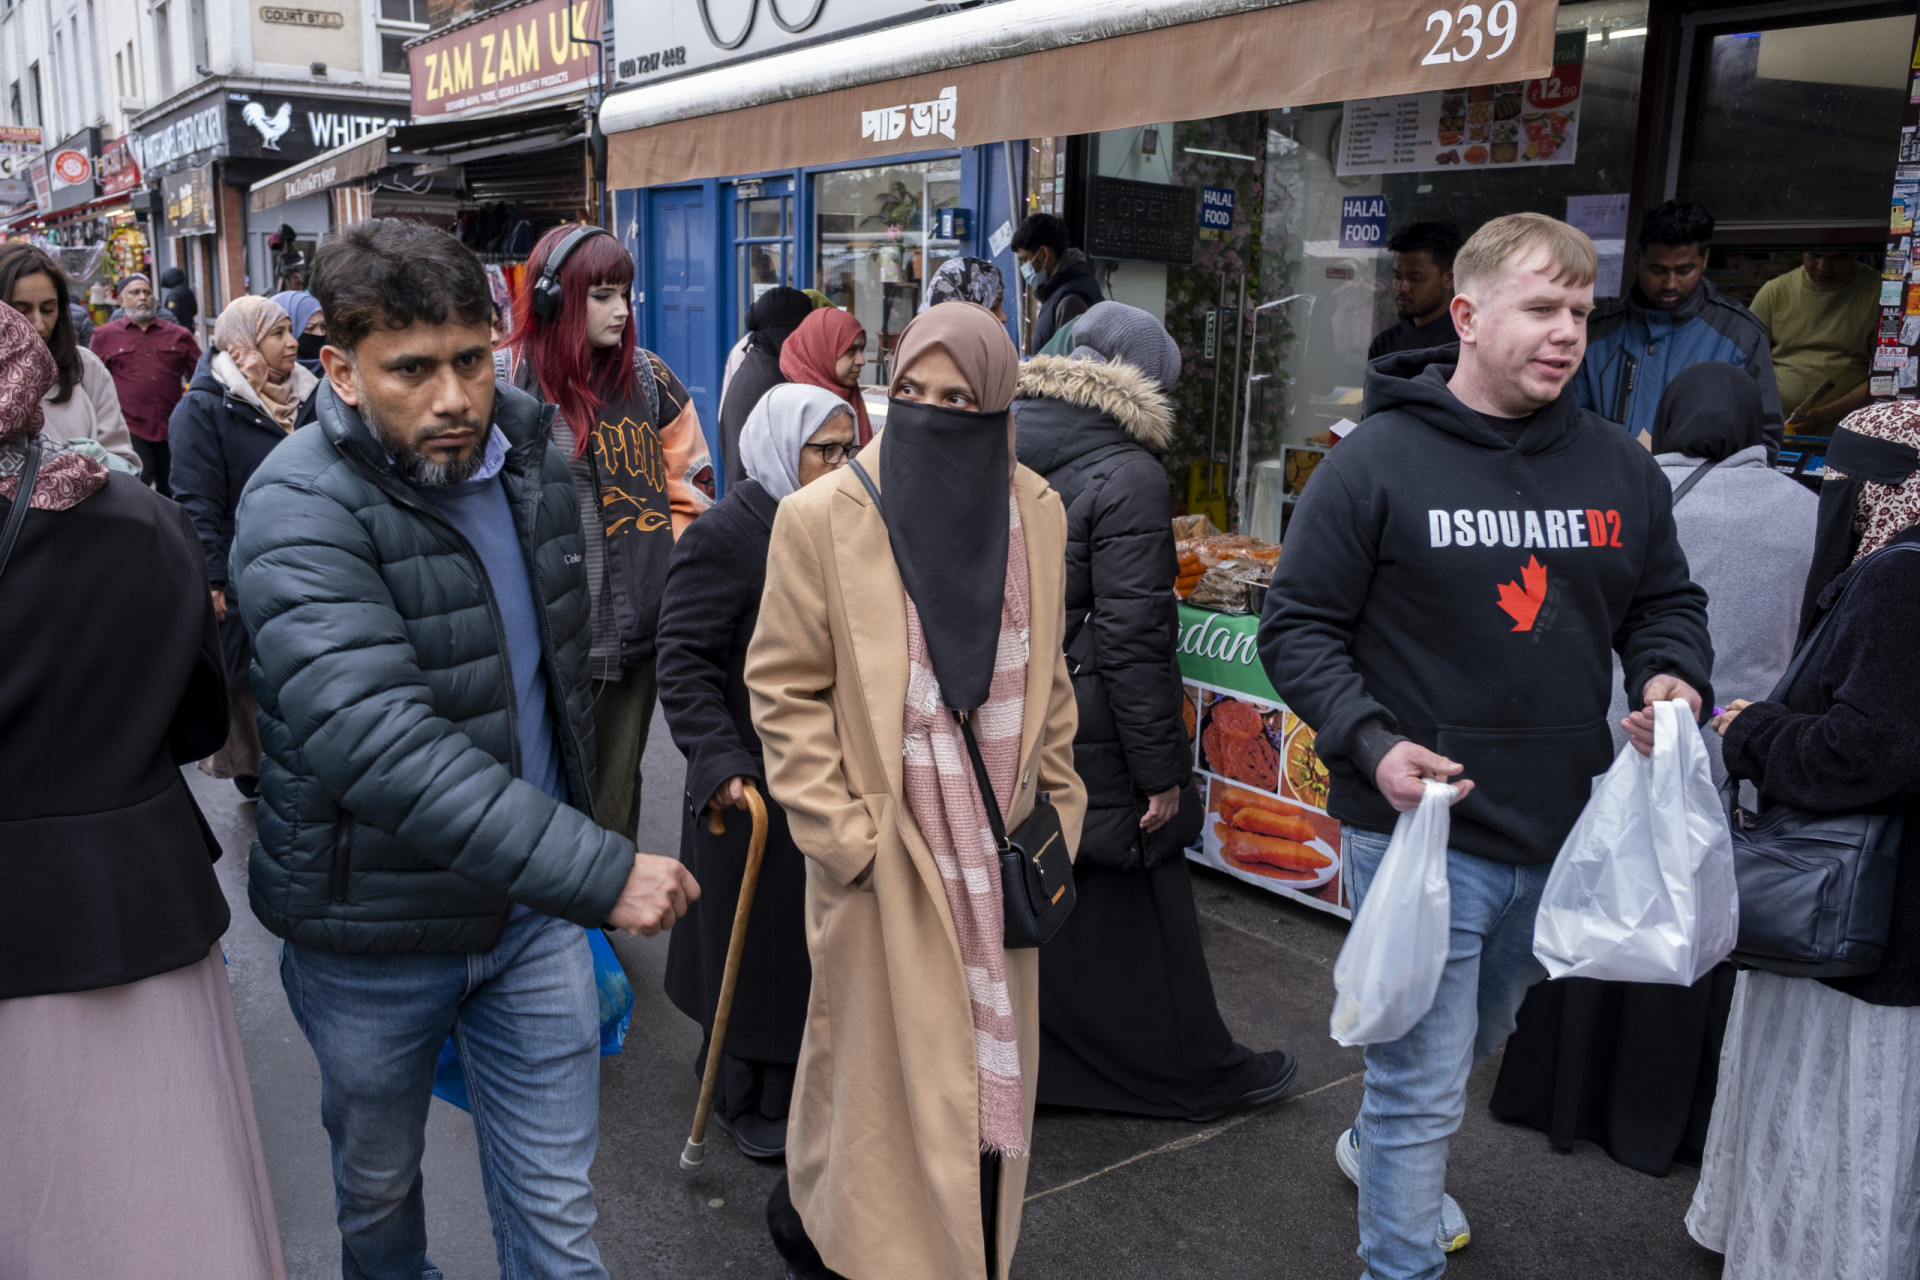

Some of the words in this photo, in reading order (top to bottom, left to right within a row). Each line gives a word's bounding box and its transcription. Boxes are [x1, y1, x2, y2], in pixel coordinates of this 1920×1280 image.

[265, 10, 303, 22] COURT
[307, 13, 320, 23] ST
[1421, 0, 1517, 66] 239
[425, 42, 473, 101] ZAM
[480, 19, 539, 85] ZAM
[549, 1, 590, 66] UK
[1555, 44, 1580, 61] rak
[619, 58, 636, 78] 020
[520, 79, 540, 93] BEAUTY
[541, 71, 569, 87] PRODUCTS
[1204, 190, 1233, 207] HALAL
[1118, 197, 1174, 222] OPEN
[1205, 209, 1230, 225] FOOD
[1344, 200, 1386, 218] HALAL
[1105, 219, 1183, 245] Welcome
[1345, 224, 1380, 242] FOOD
[1428, 509, 1623, 548] DSQUARED2
